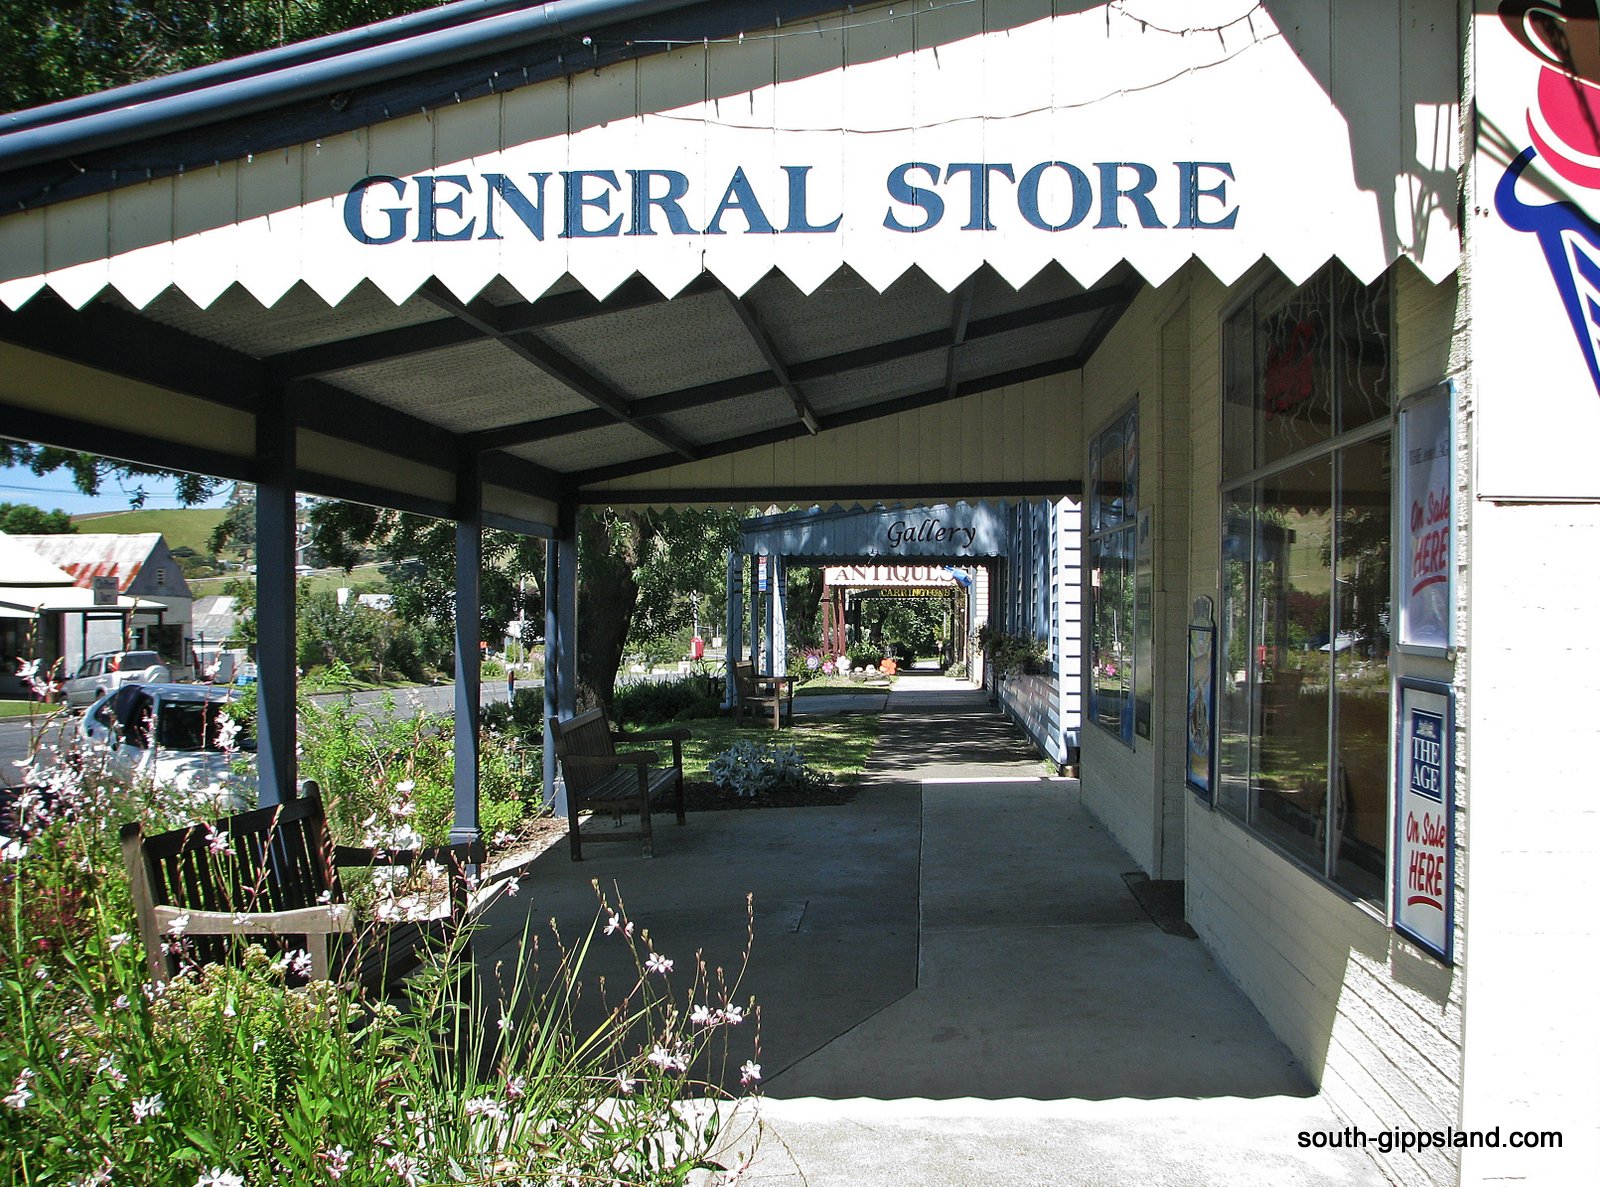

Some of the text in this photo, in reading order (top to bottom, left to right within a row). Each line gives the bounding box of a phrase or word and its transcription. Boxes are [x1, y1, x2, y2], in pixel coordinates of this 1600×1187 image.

[343, 161, 1240, 245] GENERAL STORE
[1411, 486, 1449, 533] On Sale
[887, 518, 976, 548] Gallery
[1413, 526, 1449, 578] HERE
[1412, 736, 1440, 766] THE
[1411, 762, 1440, 793] AGE
[1406, 811, 1446, 849] On Sale
[1408, 849, 1444, 897] HERE
